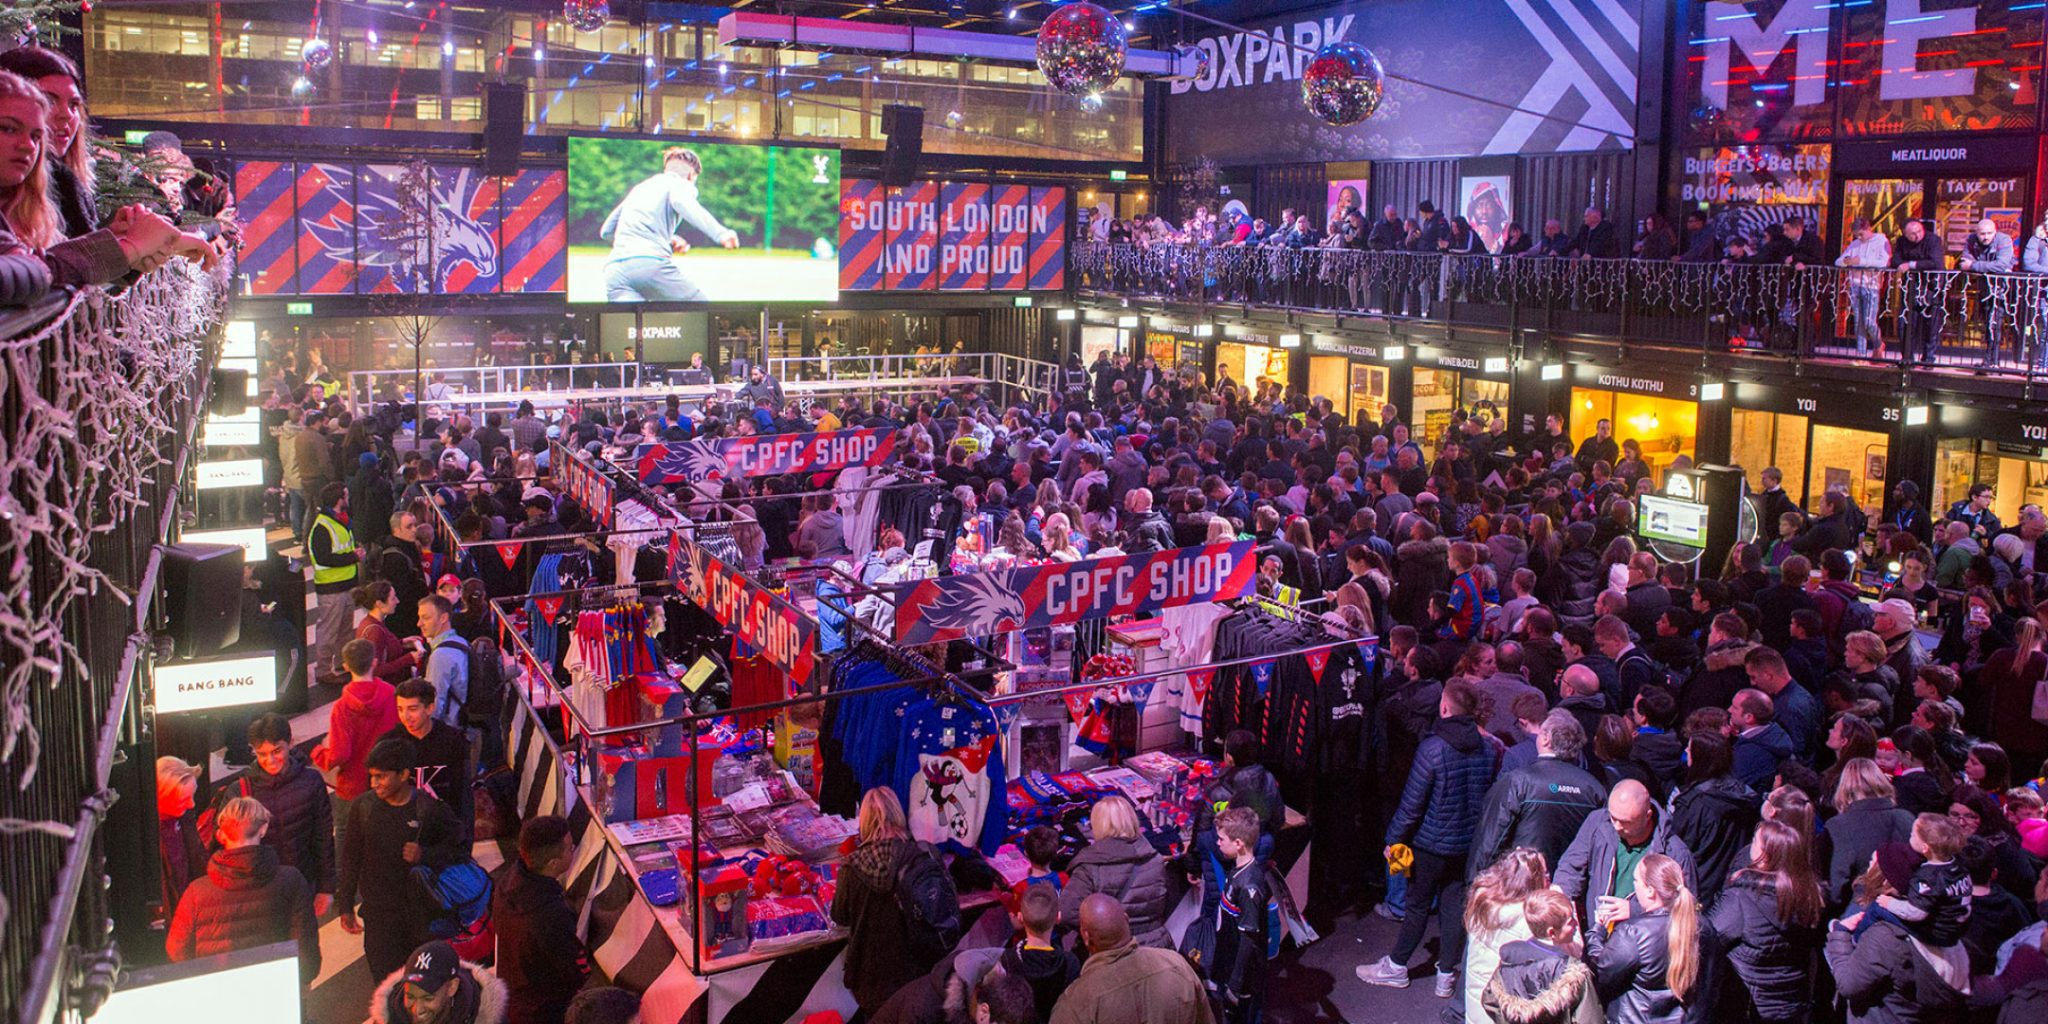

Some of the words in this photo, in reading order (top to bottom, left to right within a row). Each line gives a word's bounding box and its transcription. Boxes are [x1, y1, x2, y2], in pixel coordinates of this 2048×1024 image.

[1891, 147, 1968, 162] MEATLIQUOR
[1946, 180, 1982, 194] TAKE
[850, 200, 936, 232] SOUTH
[947, 202, 1047, 234] LONDON
[876, 244, 930, 274] AND
[942, 245, 1023, 274] PROUD
[627, 326, 682, 339] BXPARK
[1348, 345, 1377, 357] PIZZERIA
[1438, 356, 1480, 369] WINE&DELI
[1598, 374, 1630, 388] KOTHU
[1631, 377, 1664, 392] KOTHU
[1689, 385, 1697, 396] 3
[1797, 398, 1817, 411] YO!
[1882, 408, 1900, 421] 35
[2021, 424, 2047, 440] YO!
[741, 439, 805, 471] CPFC
[815, 435, 877, 465] SHOP
[1046, 564, 1135, 616] CPFC
[1150, 552, 1232, 601] SHOP
[712, 569, 751, 635] CPFC
[756, 600, 800, 671] SHOP
[1558, 784, 1581, 794] ARRIVA
[414, 951, 433, 970] NY
